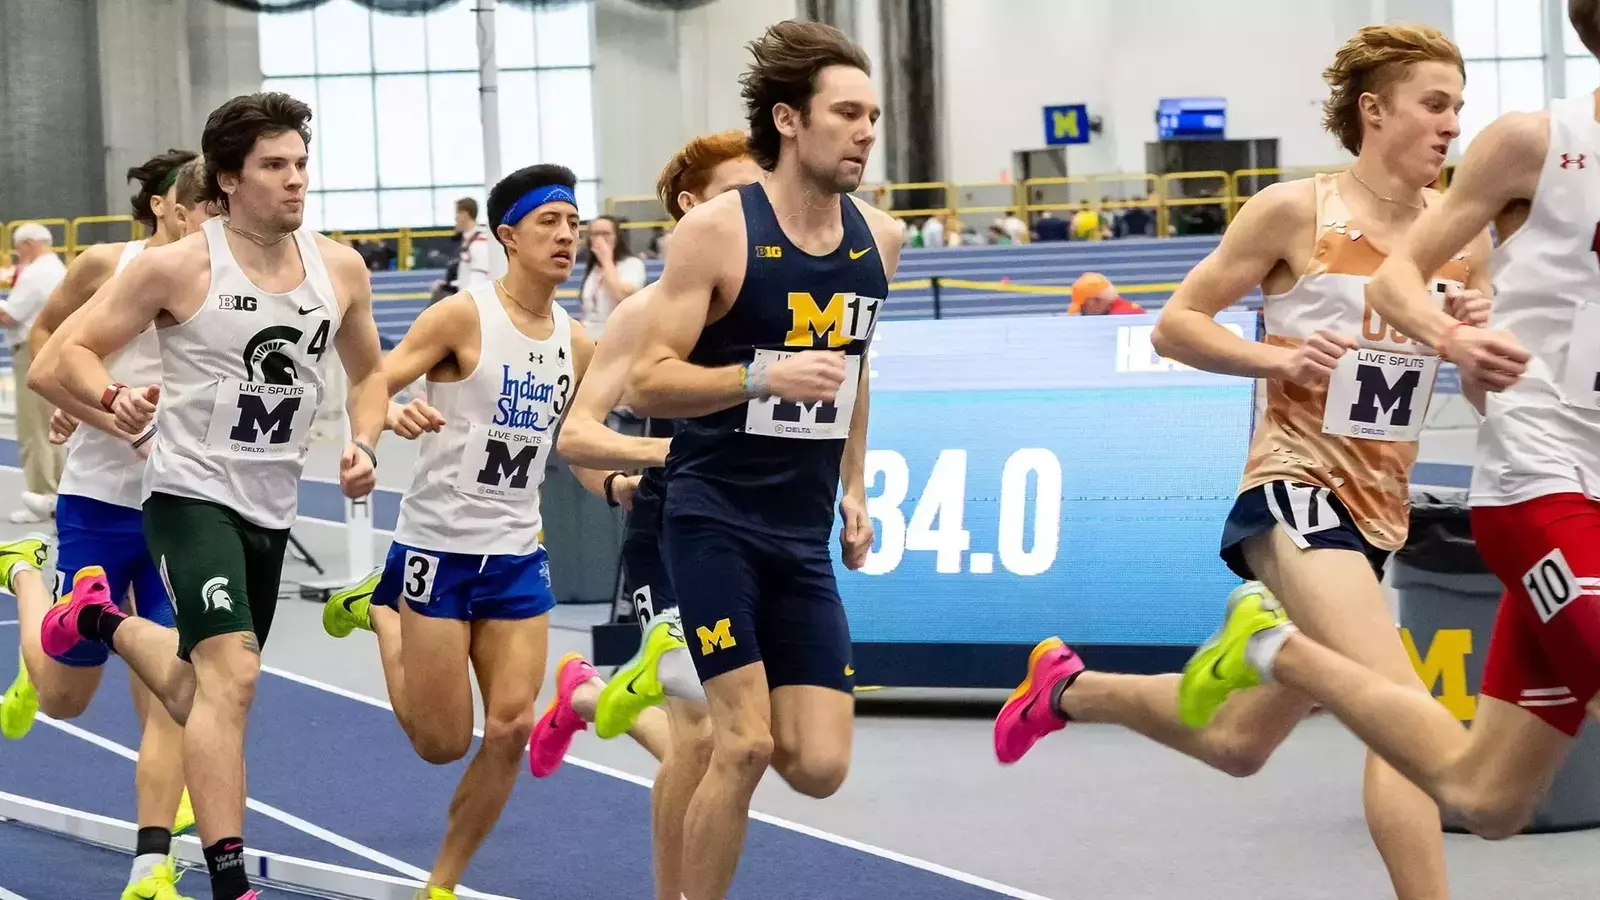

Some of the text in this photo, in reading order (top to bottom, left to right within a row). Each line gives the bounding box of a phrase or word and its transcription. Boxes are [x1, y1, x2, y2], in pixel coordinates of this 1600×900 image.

[784, 292, 856, 347] M
[847, 297, 879, 338] 11
[307, 319, 331, 363] 4
[1357, 351, 1425, 368] LIVE SPLITS
[239, 382, 304, 395] LIVE SPLITS
[500, 365, 554, 403] Indian
[553, 374, 571, 415] 3
[1349, 364, 1421, 426] M
[229, 394, 302, 444] M
[492, 397, 557, 432] State
[488, 428, 542, 445] LIVE SPLITS
[477, 439, 539, 489] M
[858, 449, 1062, 576] 34.0
[405, 555, 430, 598] 3
[1528, 558, 1570, 616] 10
[696, 617, 737, 656] M
